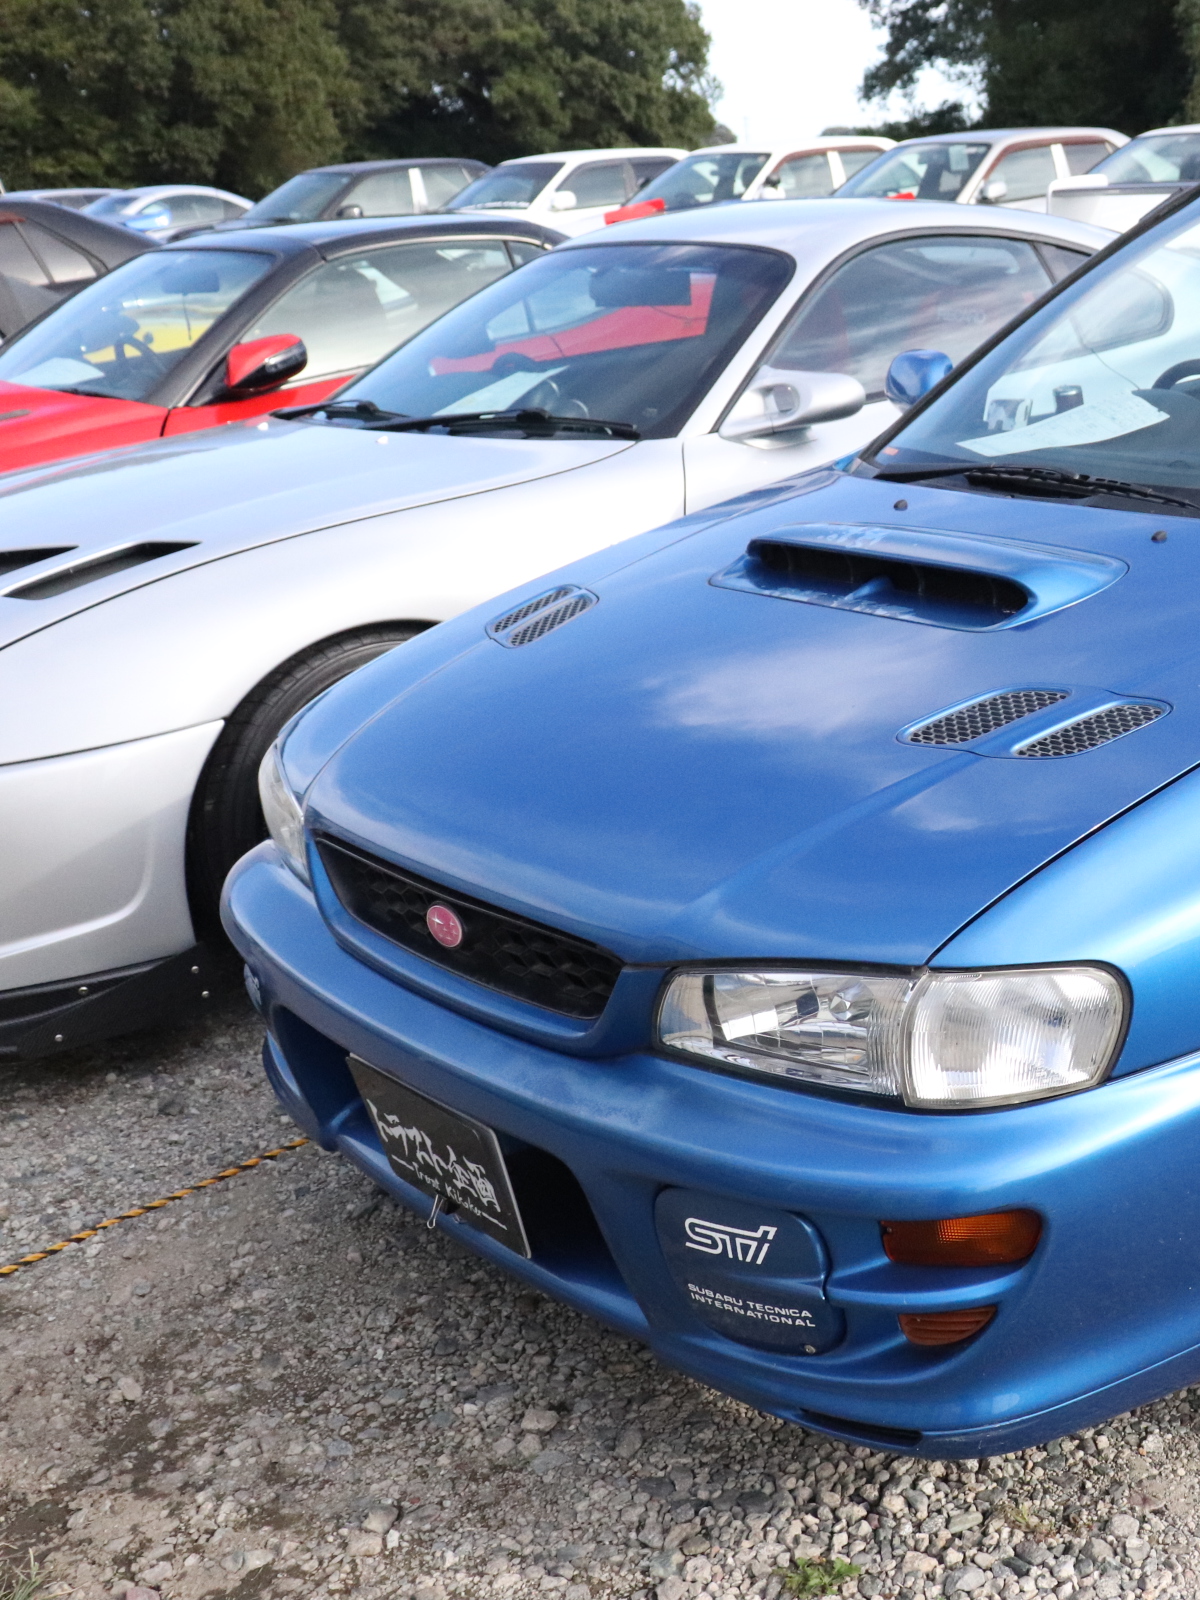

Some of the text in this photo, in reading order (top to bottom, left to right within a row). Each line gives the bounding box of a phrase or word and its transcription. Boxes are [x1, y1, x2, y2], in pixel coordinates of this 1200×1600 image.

[367, 1099, 501, 1212] トラスト企画
[688, 1283, 812, 1317] SUBARU TECNICA
[691, 1293, 816, 1327] INTERNATIONAL
